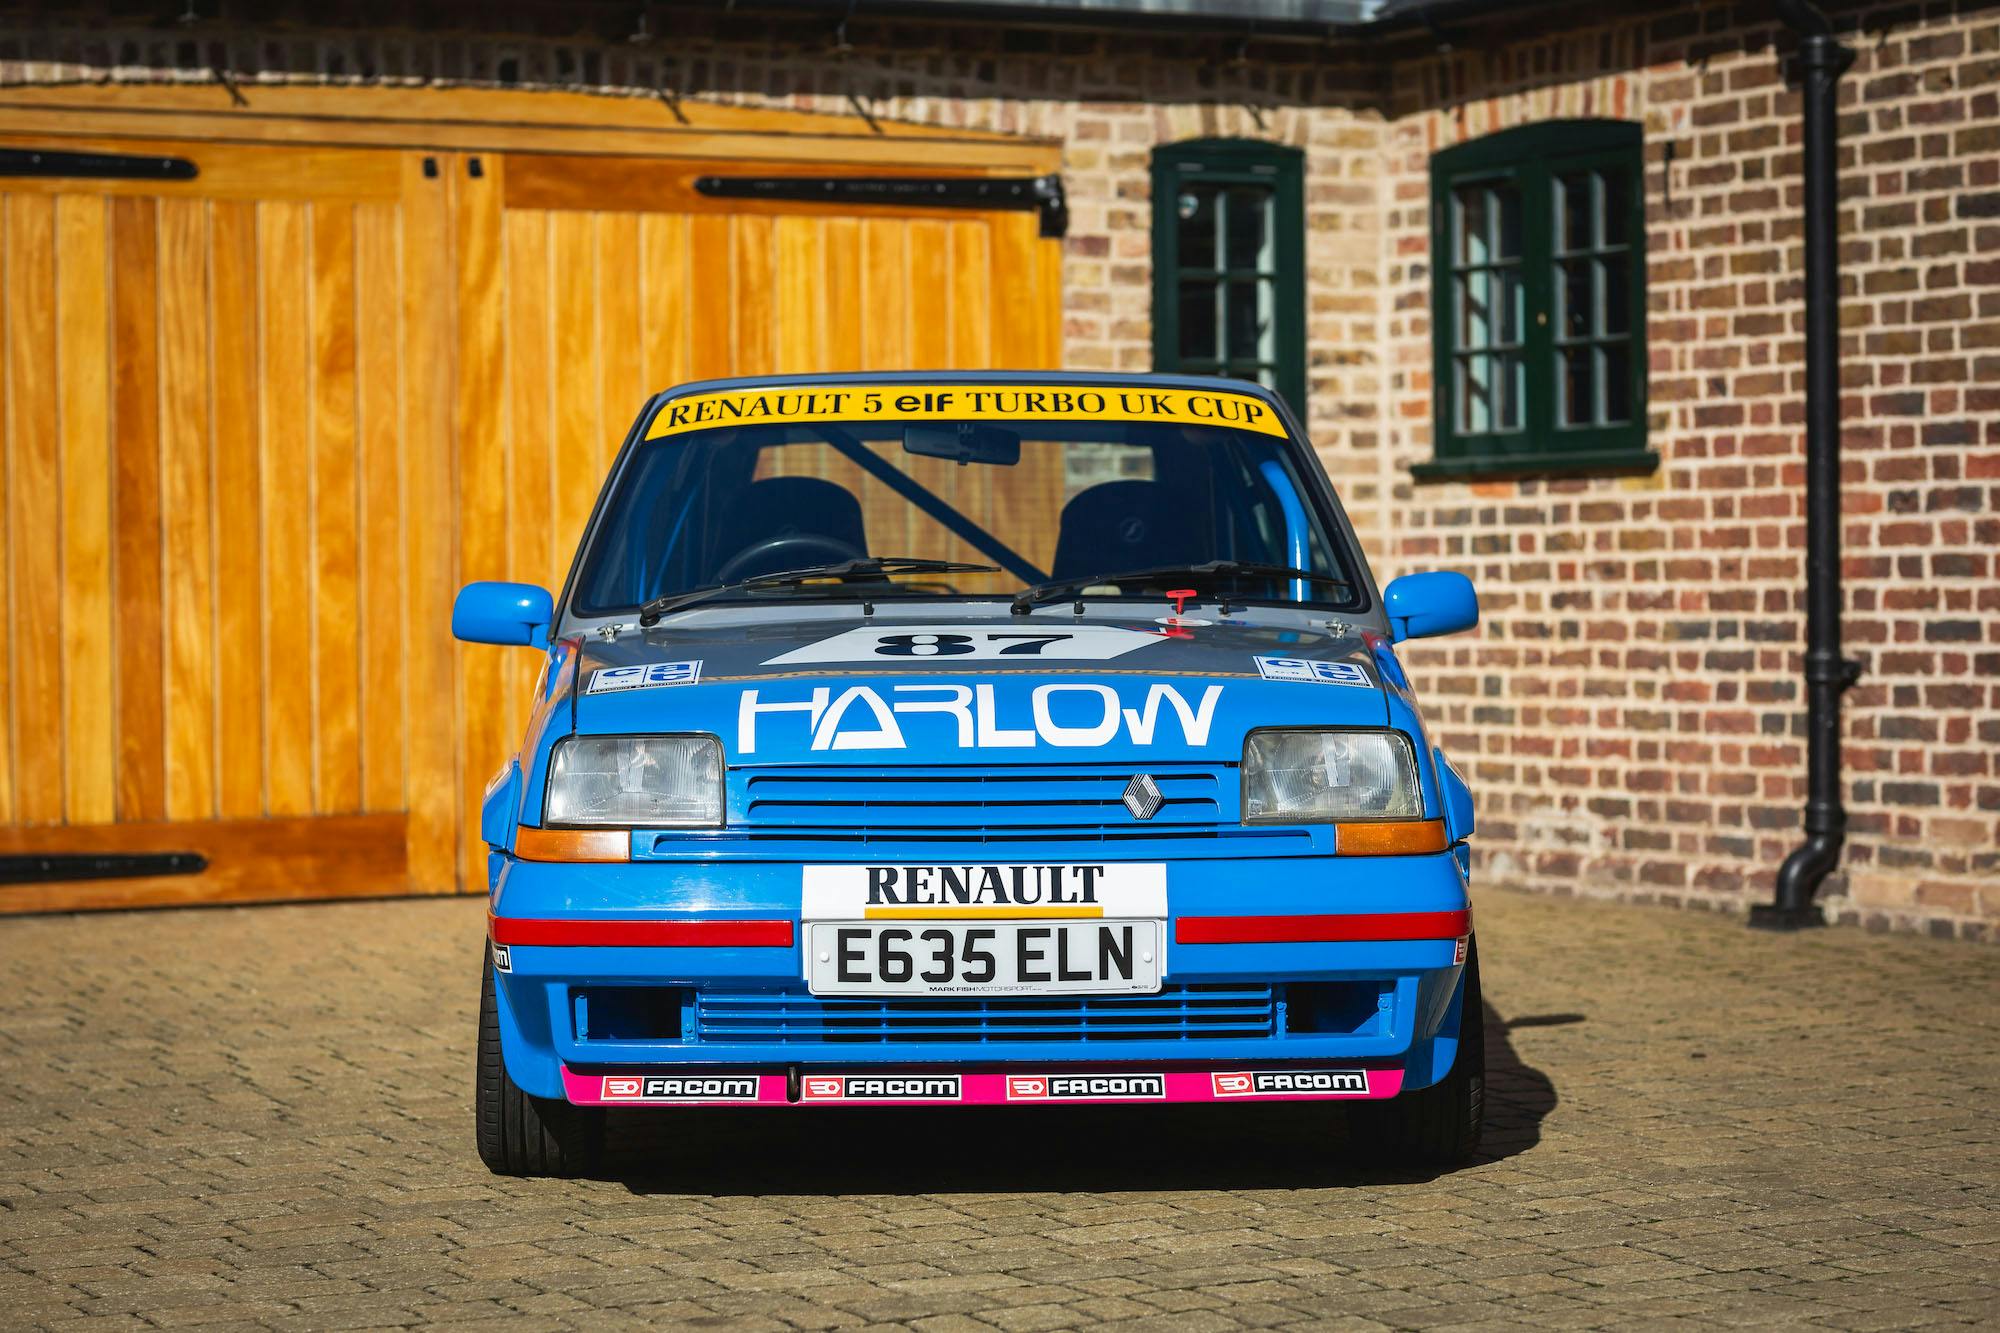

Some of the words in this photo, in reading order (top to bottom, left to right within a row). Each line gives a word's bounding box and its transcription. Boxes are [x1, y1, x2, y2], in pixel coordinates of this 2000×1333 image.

[666, 393, 850, 428] RENAULT
[863, 393, 883, 414] 5
[894, 393, 954, 413] elf
[966, 392, 1106, 414] TURBO
[1118, 393, 1177, 416] UK
[1187, 395, 1263, 424] CUP
[874, 633, 1073, 656] 87
[737, 684, 1224, 754] HARLOW
[865, 865, 1104, 905] RENAULT
[837, 928, 996, 984] E635
[1016, 926, 1134, 982] ELN
[646, 1080, 755, 1096] FACOM
[848, 1080, 959, 1096] FACOM
[1052, 1078, 1160, 1095] FACOM
[1256, 1073, 1364, 1090] FACOM
